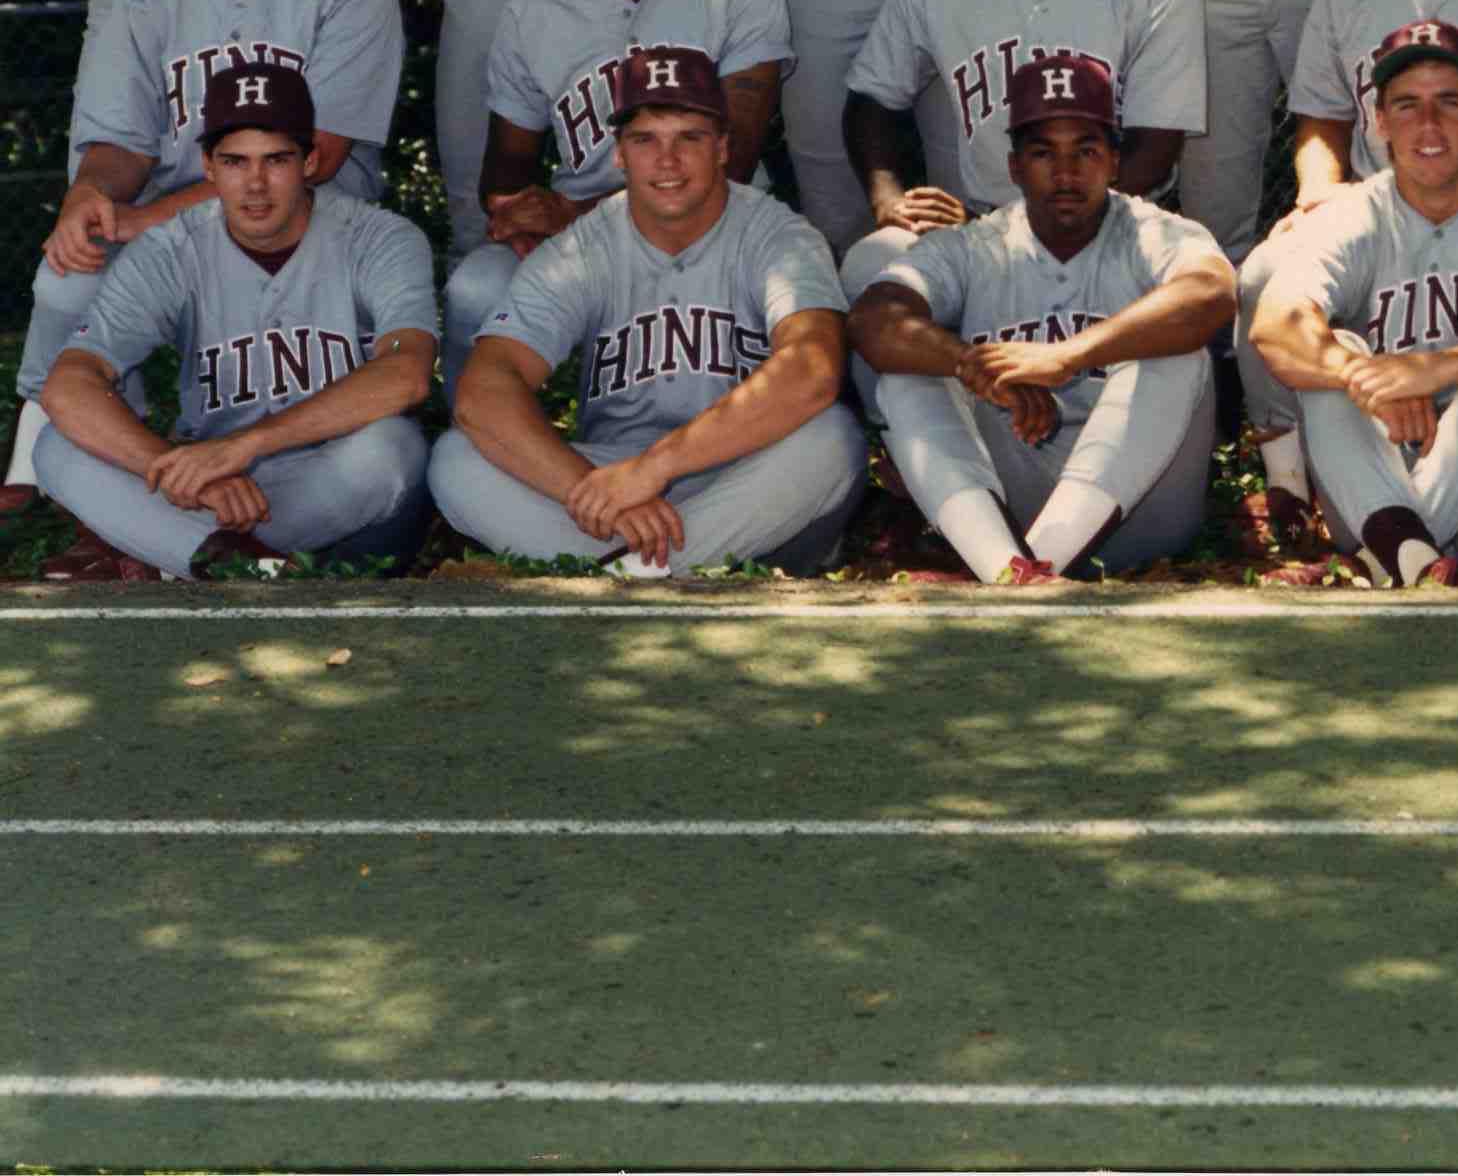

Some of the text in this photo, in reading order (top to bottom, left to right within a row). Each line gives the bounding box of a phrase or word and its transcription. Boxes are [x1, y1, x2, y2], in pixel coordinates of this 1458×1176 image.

[234, 75, 271, 108] H
[646, 59, 681, 91] H
[1041, 67, 1076, 100] H
[197, 327, 376, 414] HIND
